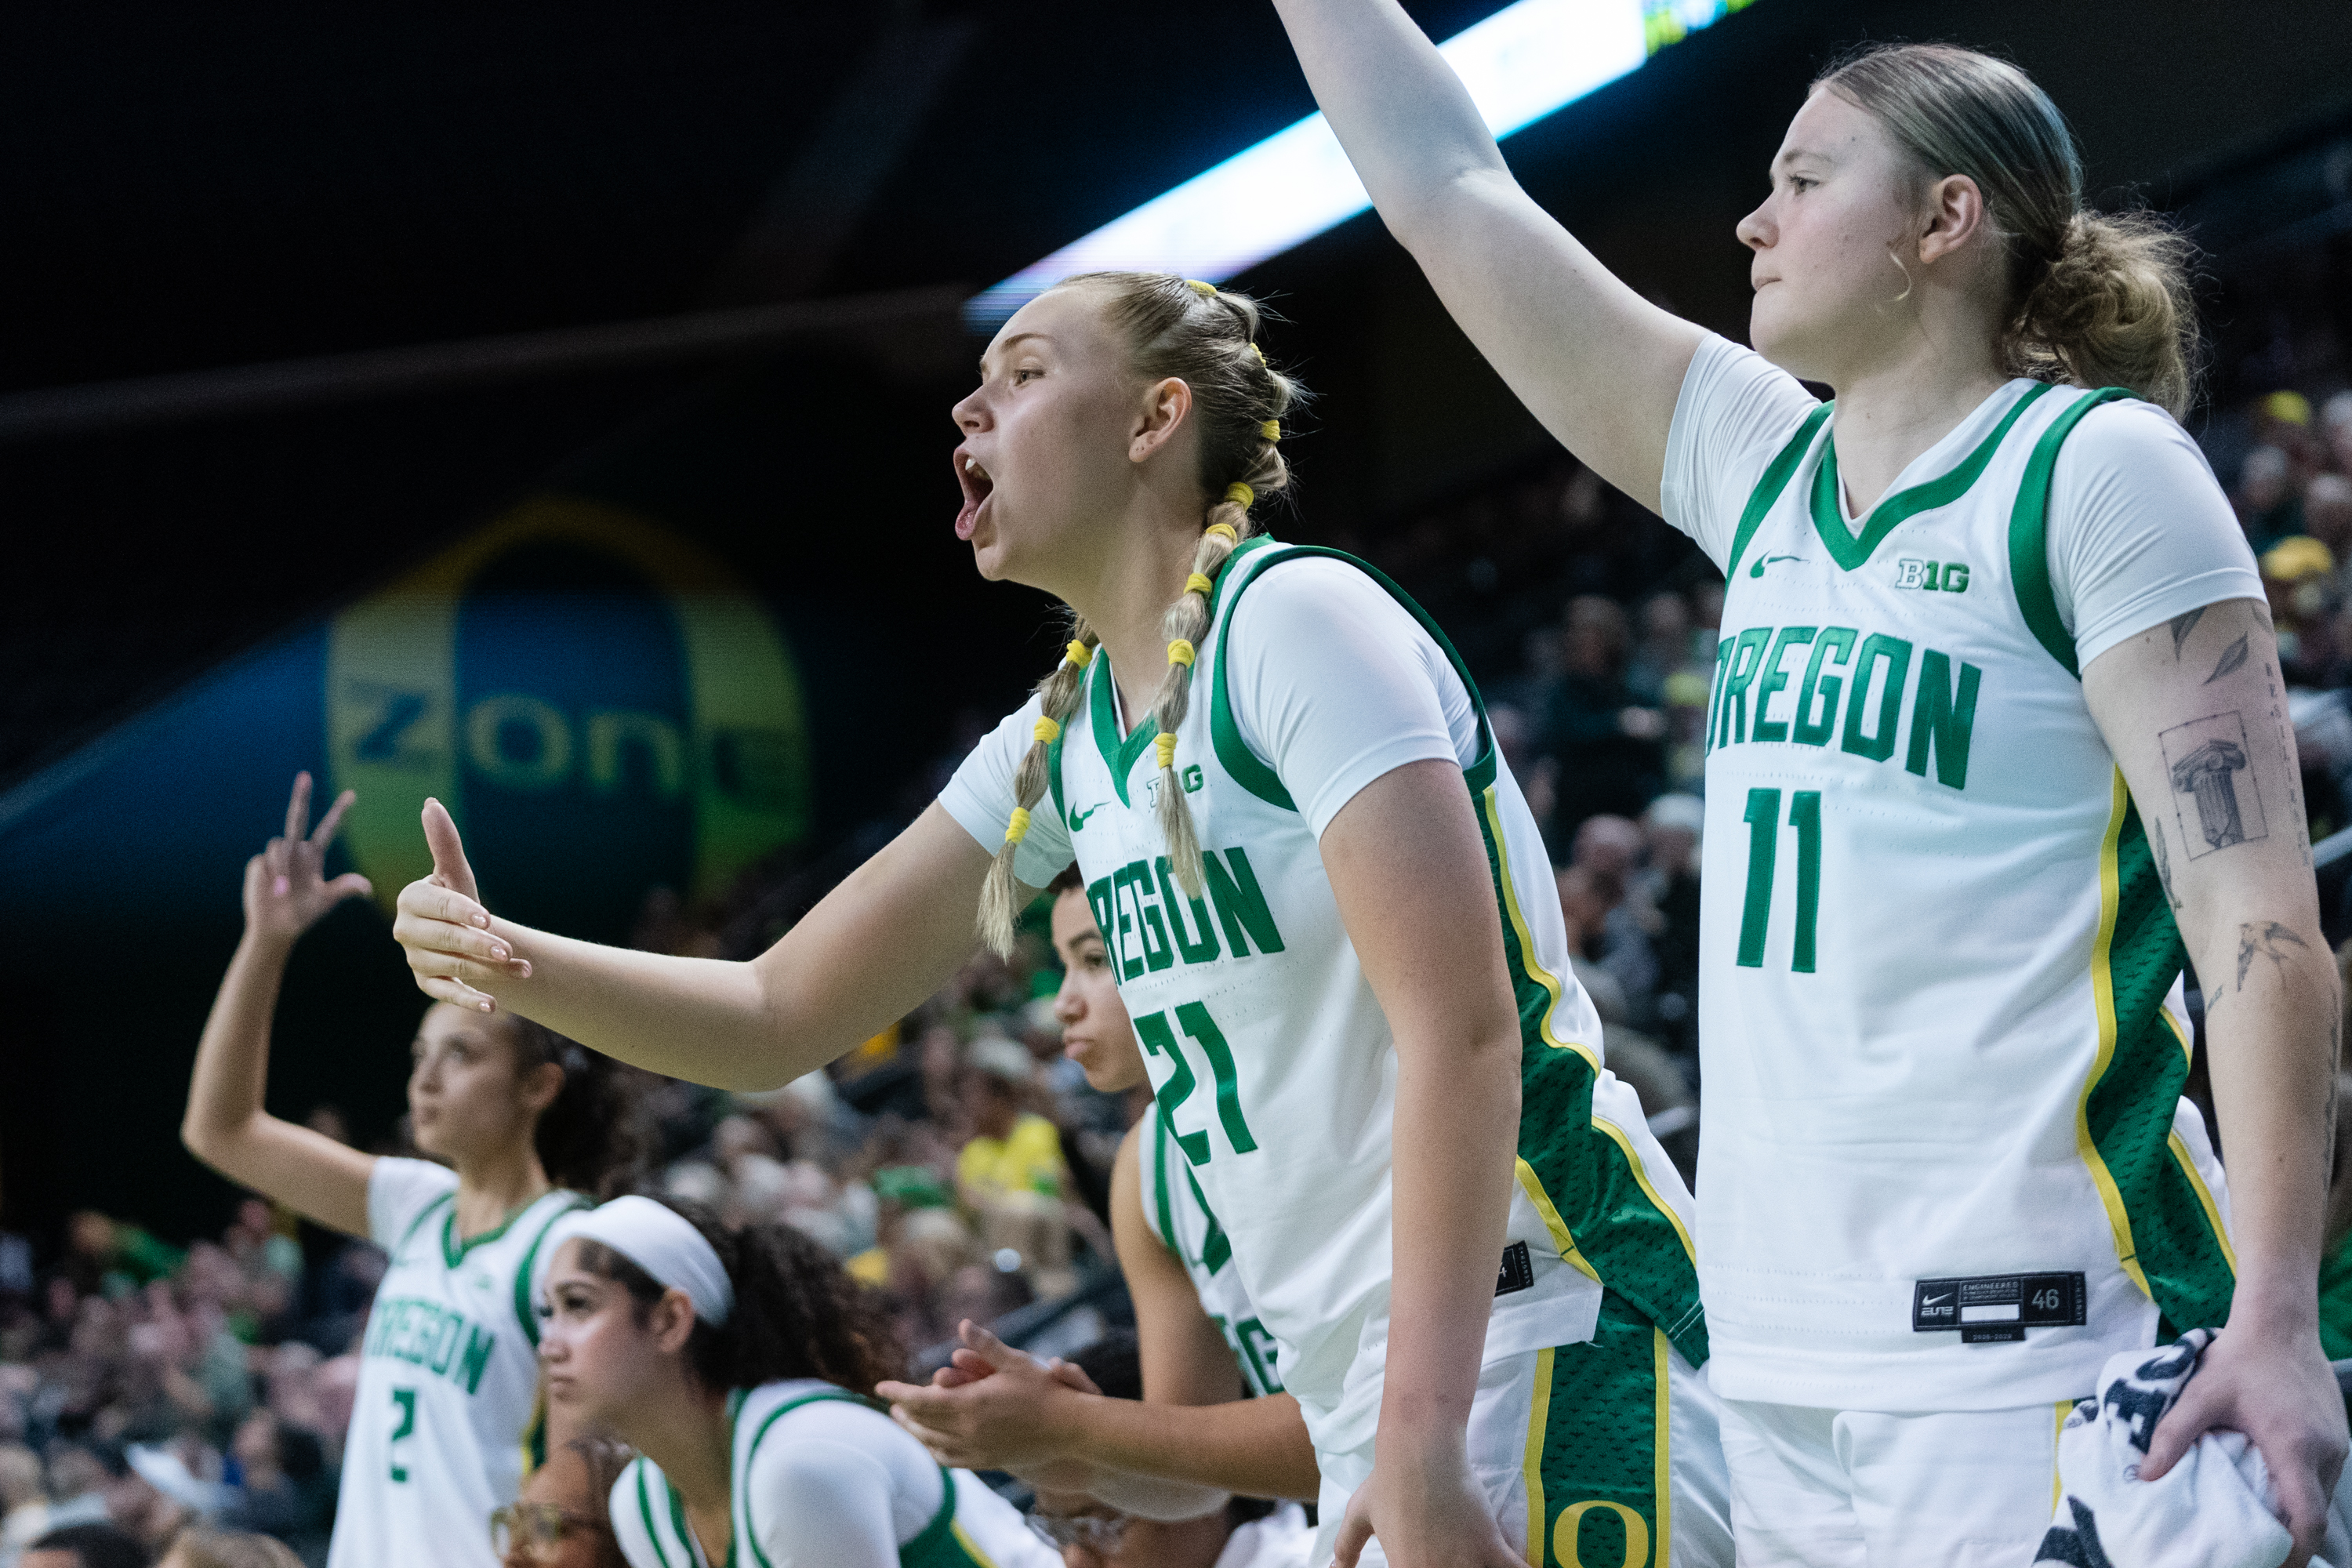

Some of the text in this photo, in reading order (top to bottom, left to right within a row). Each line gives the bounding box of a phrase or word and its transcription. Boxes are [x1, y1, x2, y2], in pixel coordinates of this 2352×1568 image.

[1895, 557, 1970, 593] B1G
[1704, 626, 1982, 791] OREGON
[1086, 846, 1286, 989] REGON
[1737, 786, 1822, 974] 11
[1133, 1000, 1258, 1167] 21
[1962, 1281, 2019, 1292] ENGINEERED
[2031, 1288, 2060, 1310] 46
[392, 1390, 416, 1483] 2
